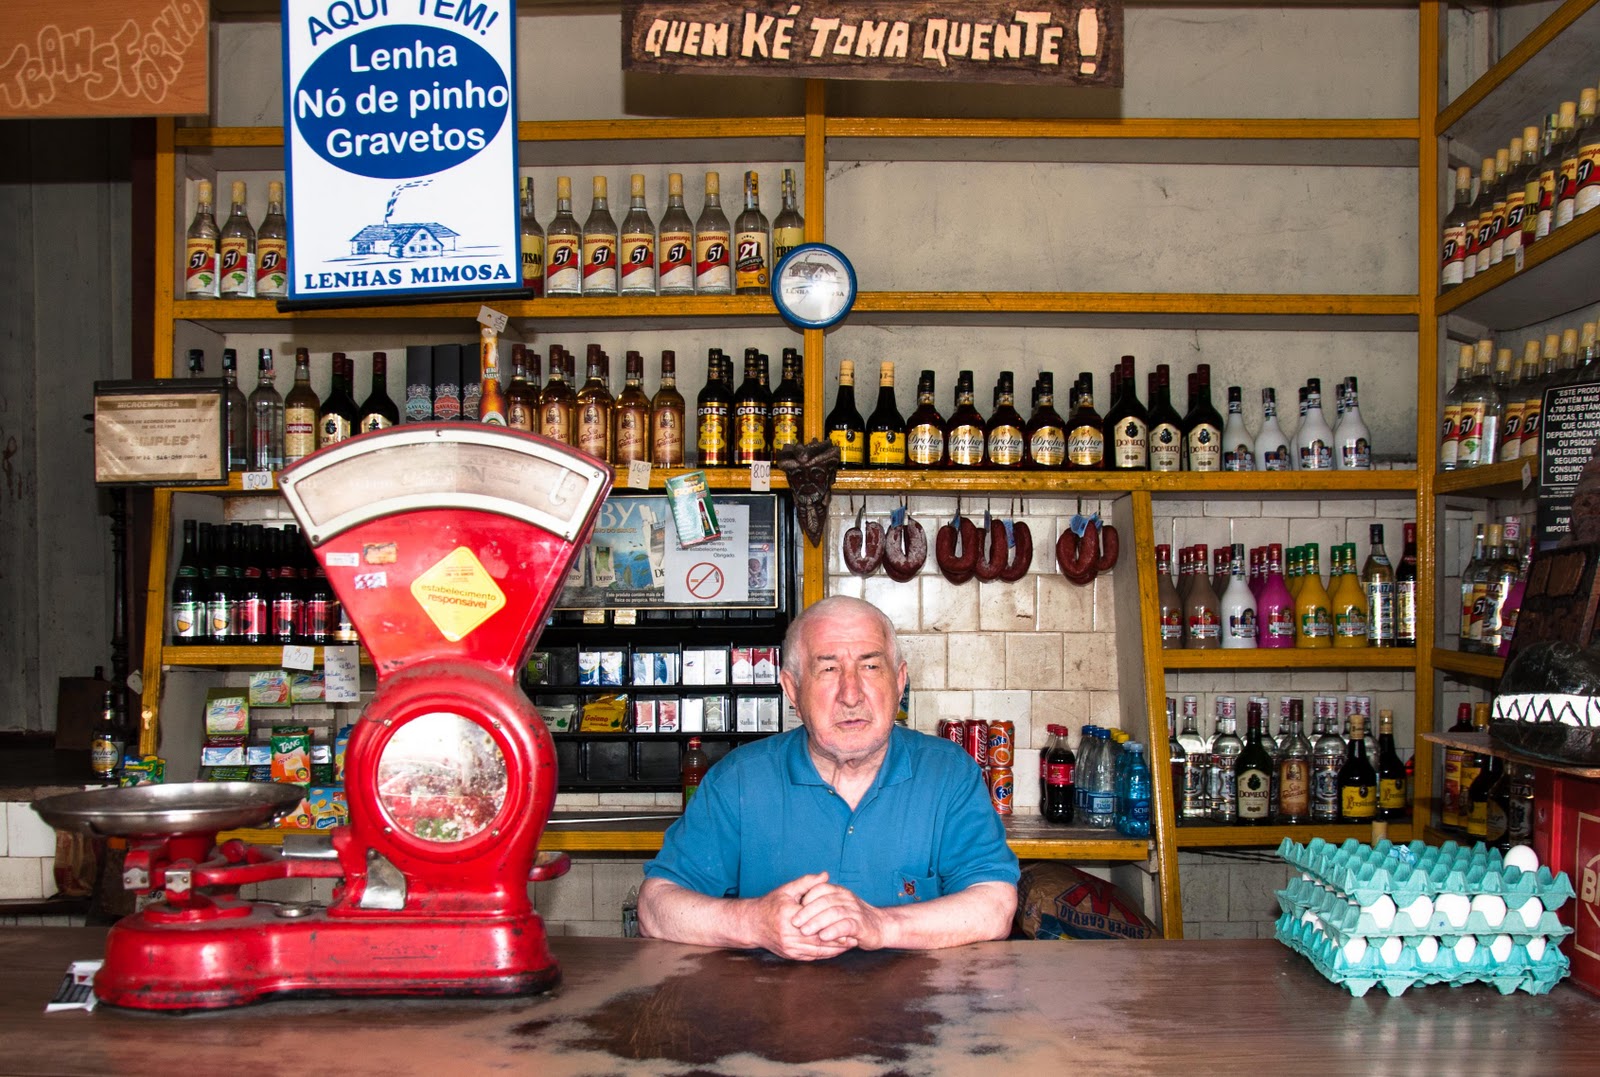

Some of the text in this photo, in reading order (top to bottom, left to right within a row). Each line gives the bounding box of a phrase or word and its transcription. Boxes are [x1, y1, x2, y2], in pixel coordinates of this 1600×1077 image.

[307, 0, 389, 46] AQUI
[645, 17, 729, 58] QUEM
[741, 5, 801, 60] KÉ
[809, 17, 910, 58] TOMA
[923, 10, 1064, 68] QUENTE
[350, 39, 458, 73] Lenha
[298, 79, 508, 119] Nó de pinho
[326, 122, 486, 158] Gravetos
[1576, 161, 1591, 186] 51
[1508, 209, 1524, 227] 51
[554, 248, 569, 265] 51
[593, 248, 608, 265] 51
[631, 247, 646, 264] 51
[669, 245, 684, 262] 51
[707, 245, 723, 262] 51
[740, 242, 758, 261] 21
[190, 252, 206, 268] 51
[223, 252, 237, 268] 51
[262, 253, 277, 269] 51
[304, 264, 512, 290] LENHAS MIMOSA
[1577, 386, 1600, 395] PRODU
[1554, 394, 1600, 405] CONTÉM MAIS
[697, 407, 727, 416] GOLF
[737, 406, 767, 416] GOLF
[772, 407, 802, 416] GOLF
[1567, 403, 1600, 412] SUBSTÂN
[1459, 416, 1474, 432] 51
[1504, 420, 1520, 436] 51
[1524, 414, 1540, 433] 51
[1561, 422, 1576, 430] QUE
[908, 434, 943, 445] Dreher
[949, 434, 984, 445] Dreher
[988, 434, 1023, 446] Dreher
[1546, 429, 1593, 439] DEPENDÊNCIA
[1030, 435, 1065, 447] Dreher
[1068, 435, 1103, 447] Dreher
[1116, 439, 1146, 447] DOMECQ
[1558, 438, 1597, 447] OU PSÍQUIC
[1151, 445, 1180, 454] DOMECQ
[1190, 445, 1220, 454] DOMECQ
[1546, 447, 1592, 456] NÃO EXISTEM
[1554, 456, 1587, 465] SEGUROS
[1549, 465, 1584, 473] CONSUMO
[420, 584, 497, 601] estabelecimento
[427, 593, 488, 609] responsável
[212, 697, 243, 708] HALLS
[585, 714, 609, 722] Goiano
[279, 739, 301, 753] TANG
[1316, 758, 1344, 766] NIKITA
[1239, 789, 1270, 798] DOMECQ
[1108, 920, 1145, 939] SUPER
